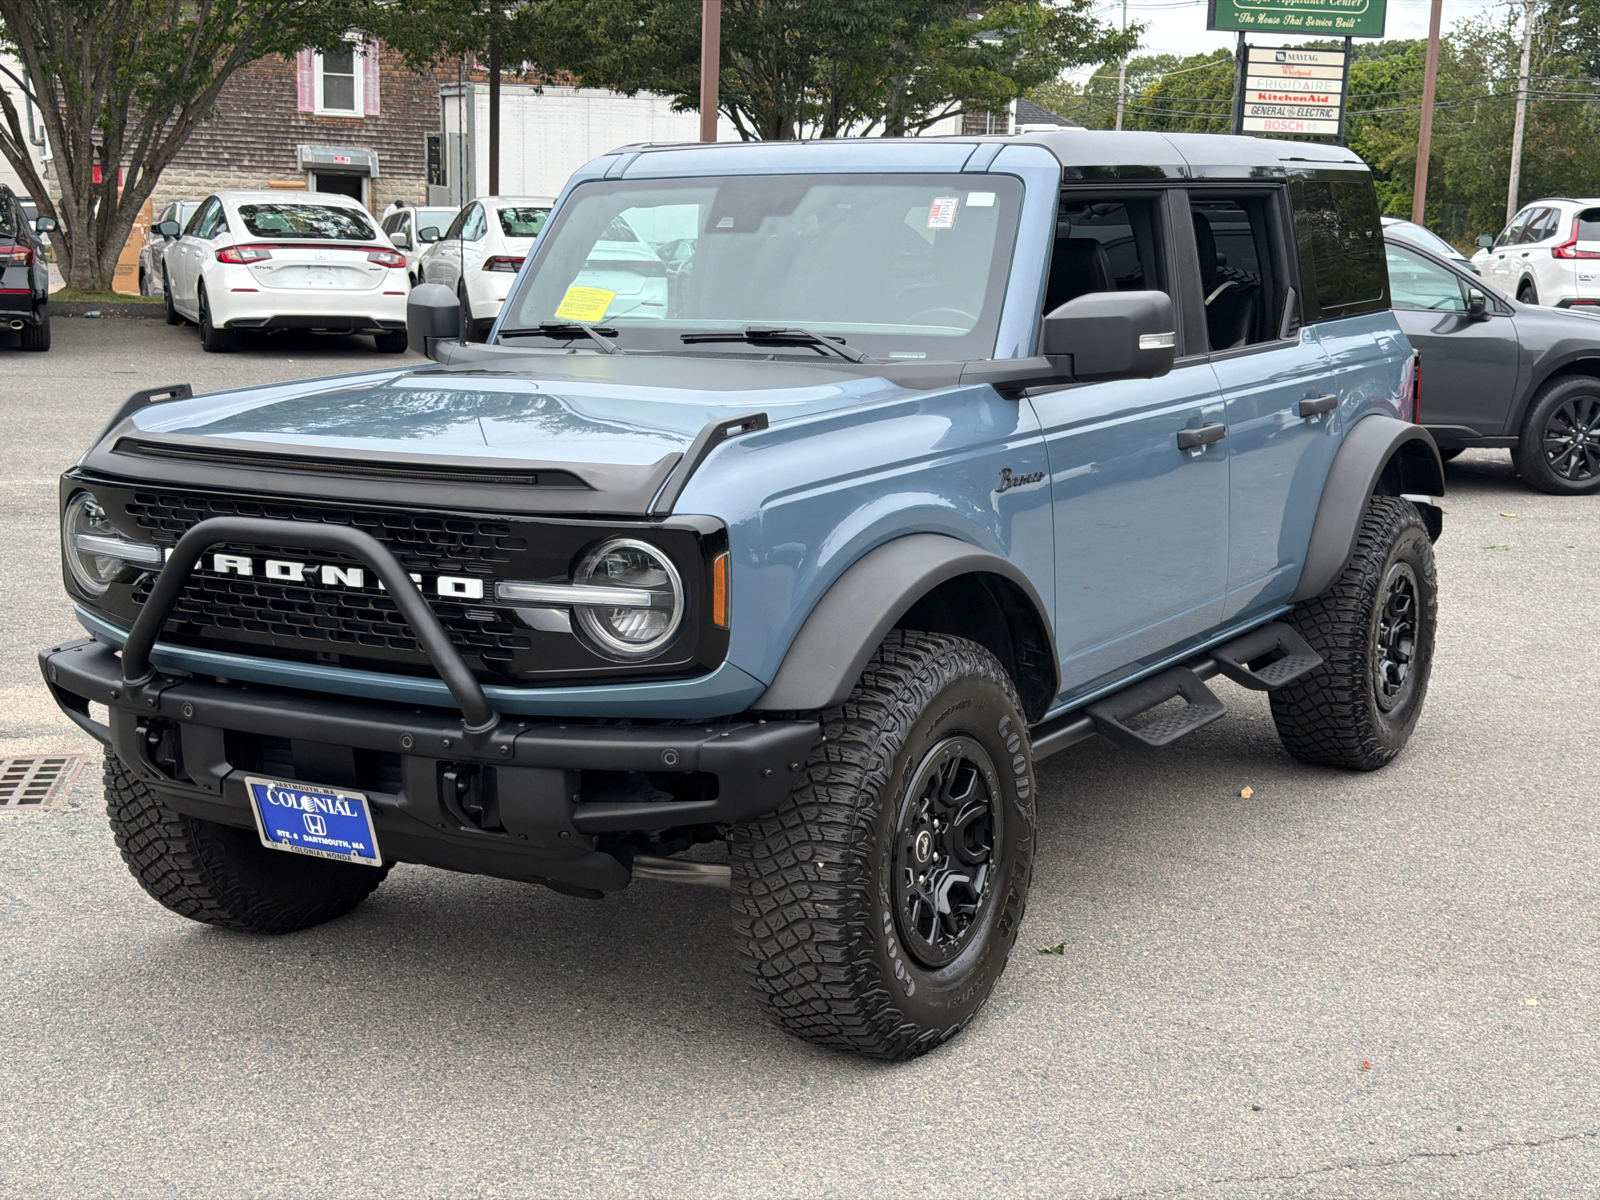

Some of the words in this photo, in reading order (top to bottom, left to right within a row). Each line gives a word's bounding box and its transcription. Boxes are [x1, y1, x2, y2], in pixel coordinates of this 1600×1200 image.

[1257, 12, 1281, 24] House
[1282, 14, 1304, 25] That
[1305, 16, 1333, 27] Service
[1288, 54, 1318, 62] MAYTAG
[1257, 79, 1332, 91] FRIGIDAIRE
[1258, 92, 1329, 103] KitchenAid
[1251, 106, 1286, 116] GENERAL
[1296, 107, 1334, 118] ELECTRIC
[1264, 120, 1304, 131] BOSCH
[165, 548, 483, 600] RONO
[274, 781, 321, 794] DARTMOUTH,
[266, 788, 358, 817] COLONIAL
[303, 834, 351, 849] DARTMOUTH,
[351, 842, 365, 850] MA
[290, 845, 325, 858] COLONIAL
[326, 851, 353, 862] HONDA
